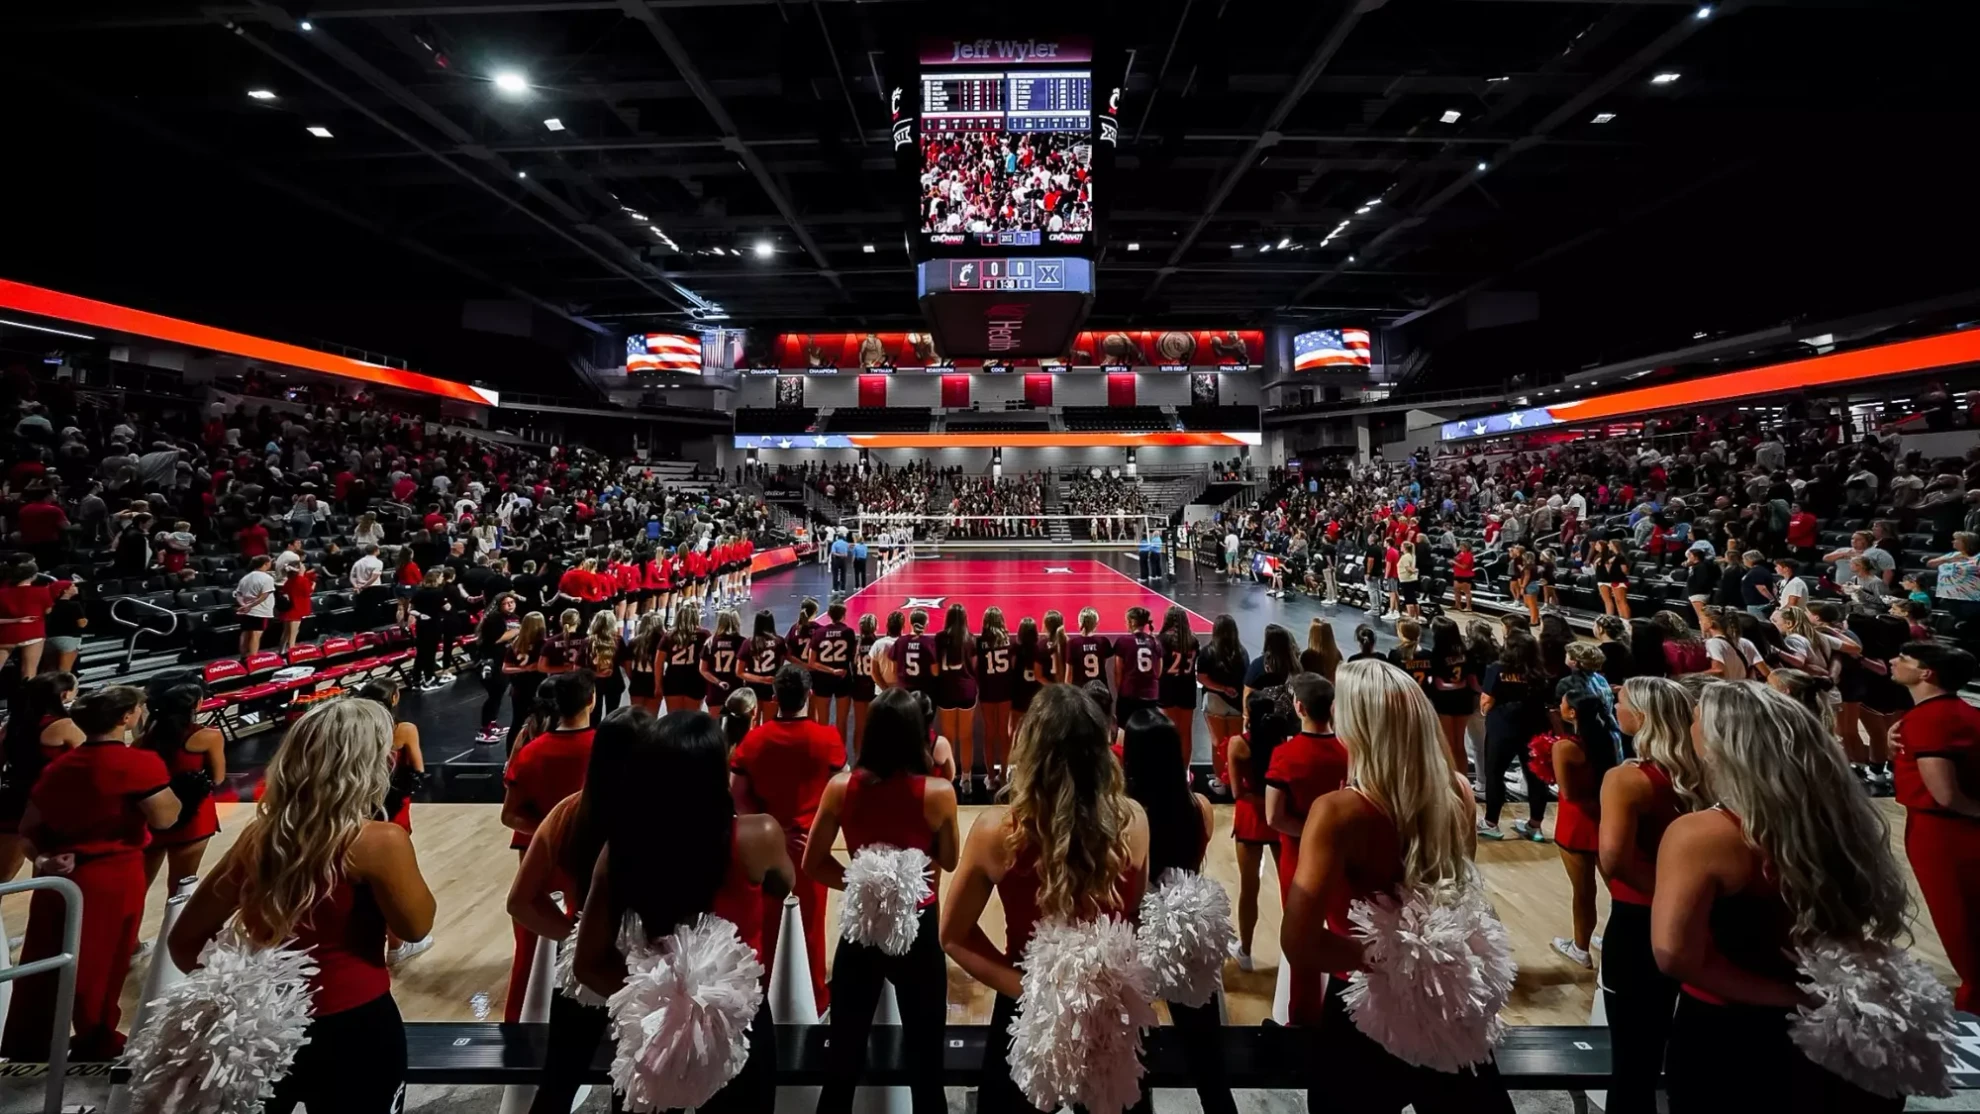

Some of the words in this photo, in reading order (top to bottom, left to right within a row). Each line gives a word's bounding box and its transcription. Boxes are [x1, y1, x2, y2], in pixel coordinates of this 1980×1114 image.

[952, 39, 993, 62] Jeff
[995, 39, 1059, 62] Wyler
[991, 262, 999, 276] 0
[1017, 262, 1025, 276] 0
[988, 321, 1023, 352] Health
[671, 644, 695, 665] 21
[714, 650, 735, 672] 17
[819, 640, 848, 662] 22
[985, 649, 1009, 674] 15
[1137, 648, 1152, 672] 6
[906, 652, 920, 676] 5
[1083, 653, 1099, 678] 9
[0, 1064, 38, 1077] NO
